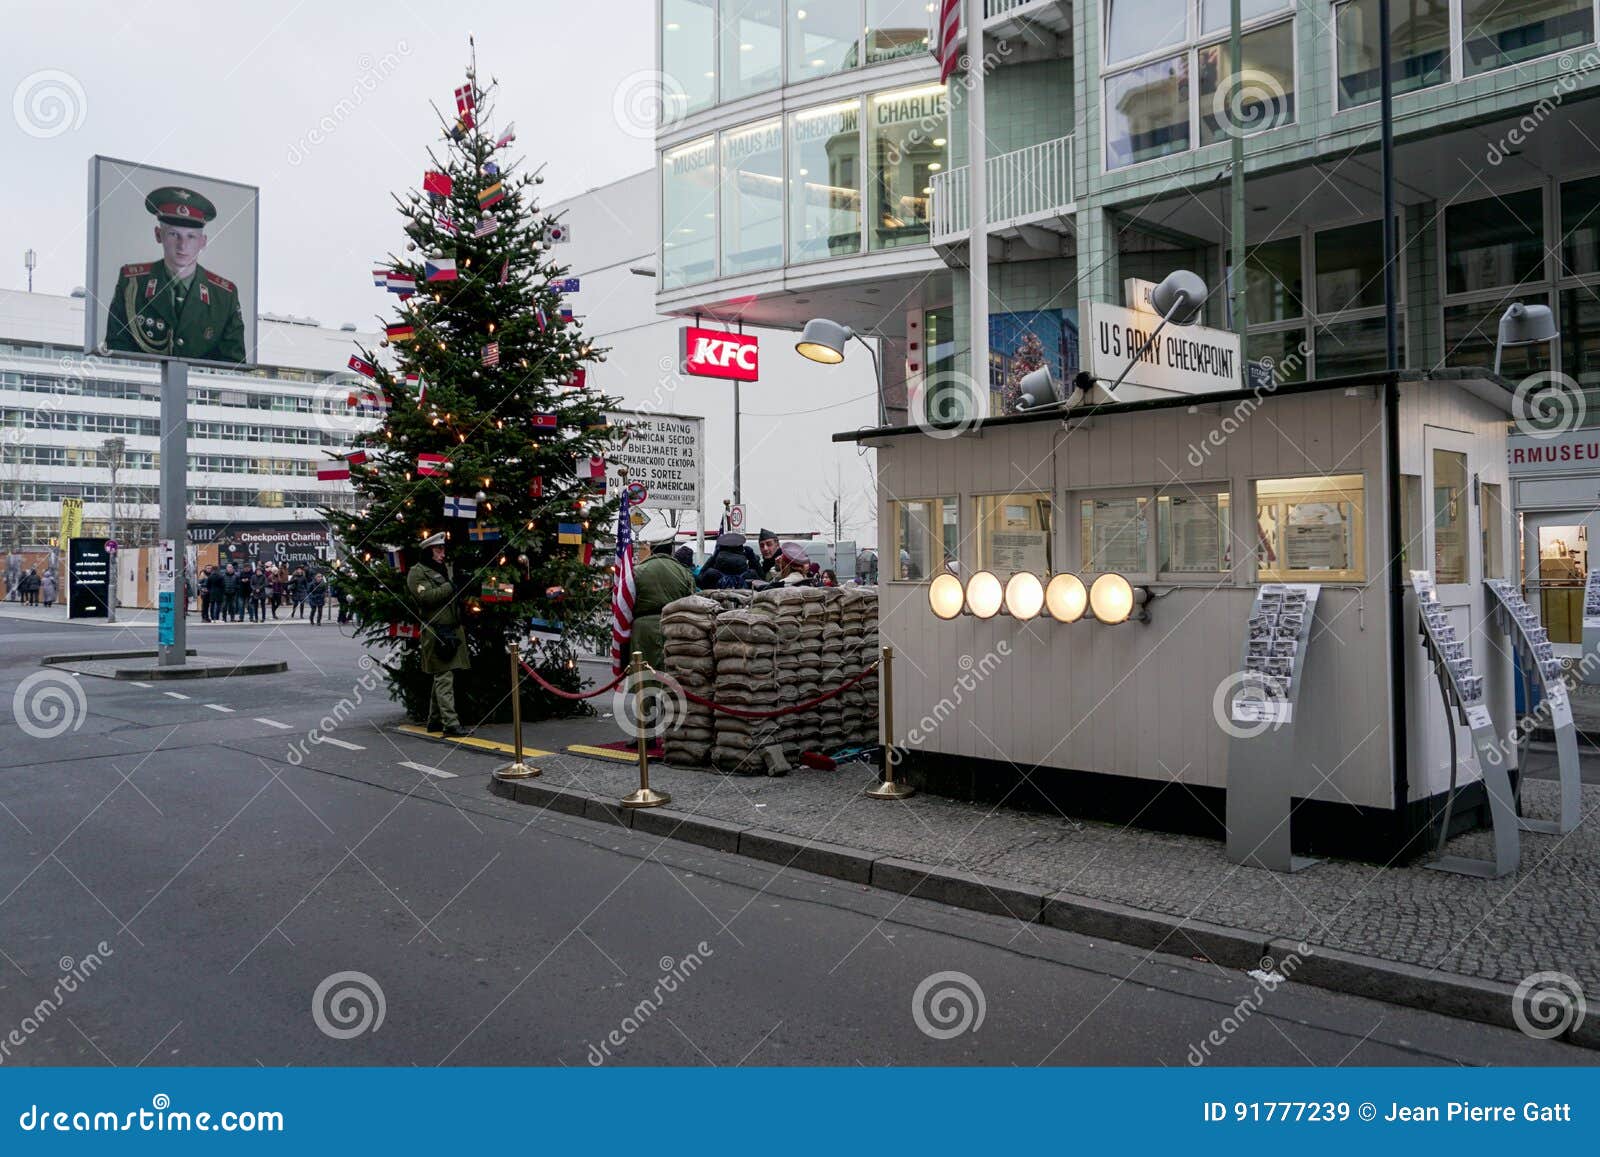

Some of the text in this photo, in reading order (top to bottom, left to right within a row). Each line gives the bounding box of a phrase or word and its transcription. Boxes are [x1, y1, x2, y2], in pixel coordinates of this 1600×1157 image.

[729, 133, 762, 158] HAUS
[877, 93, 946, 125] CHARLIE
[693, 337, 758, 371] KFC
[1126, 328, 1162, 365] ARMY
[1166, 337, 1234, 379] CHECKPOINT
[657, 422, 691, 434] LEAVING
[668, 434, 695, 446] SECTOR
[628, 443, 678, 456] ВЫЕЗЖАЕТЕ
[682, 447, 693, 457] ИЗ
[1508, 443, 1599, 464] RMUSEU
[667, 458, 696, 468] СЕКТОРА
[627, 467, 682, 480] OUS SORTEZ
[63, 499, 83, 508] ATM
[241, 532, 289, 544] Checkpoint
[291, 532, 321, 541] Charlie
[281, 553, 316, 561] CURTAIN
